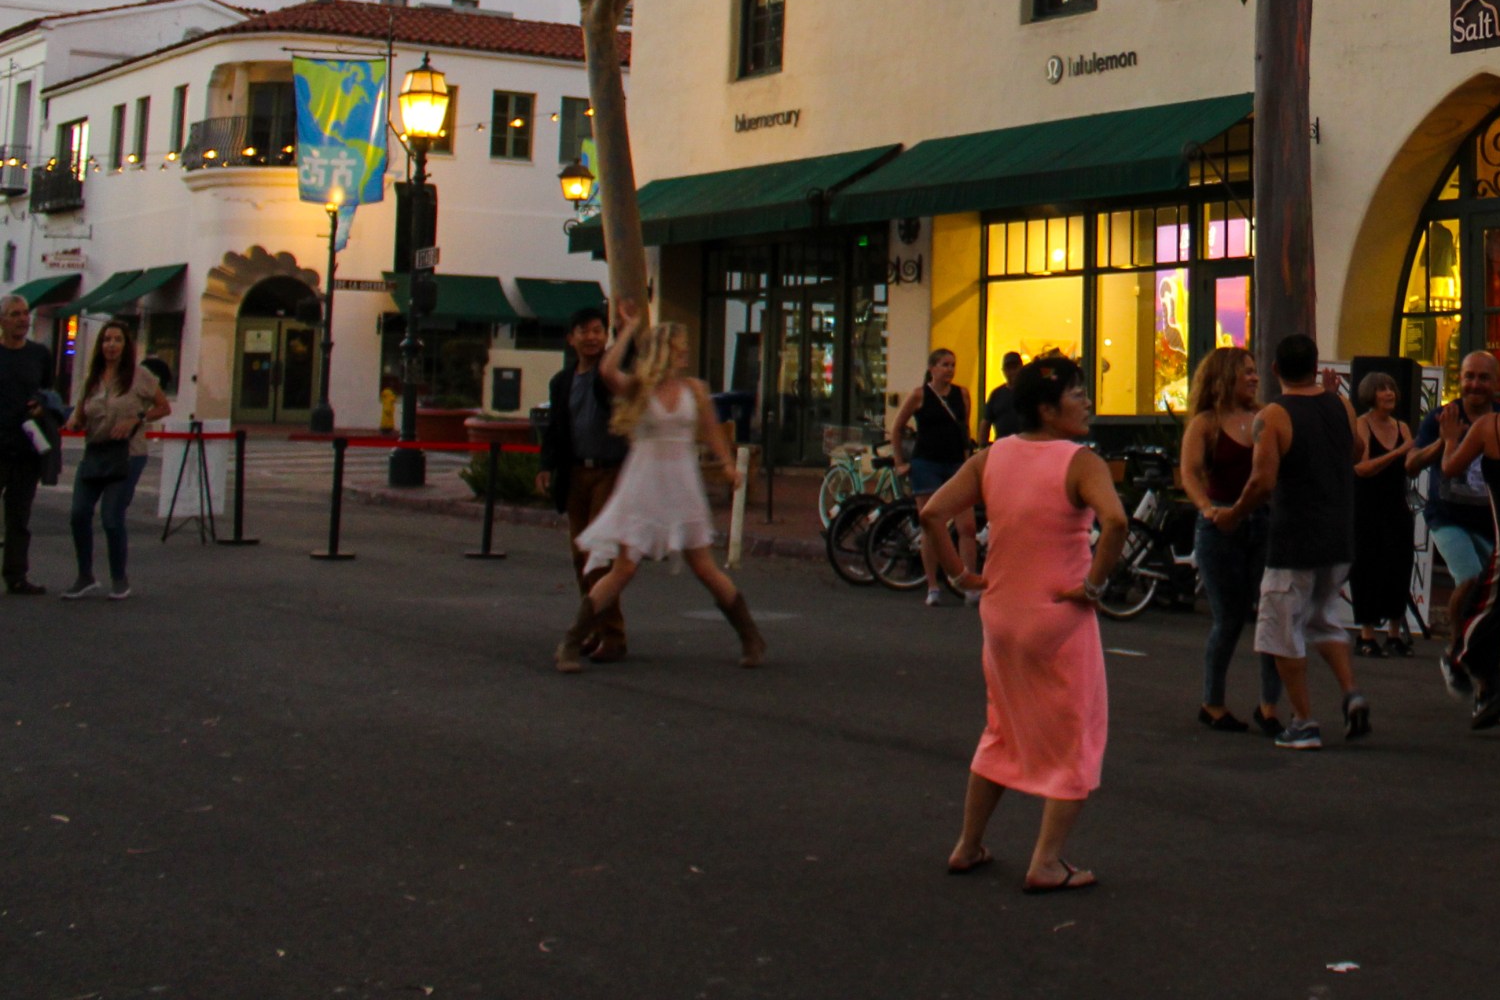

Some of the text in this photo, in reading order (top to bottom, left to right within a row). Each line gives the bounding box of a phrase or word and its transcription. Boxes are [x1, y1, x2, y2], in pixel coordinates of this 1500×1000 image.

[1452, 10, 1493, 44] Salt
[1068, 50, 1137, 77] lululemon
[735, 108, 801, 133] bluemercury
